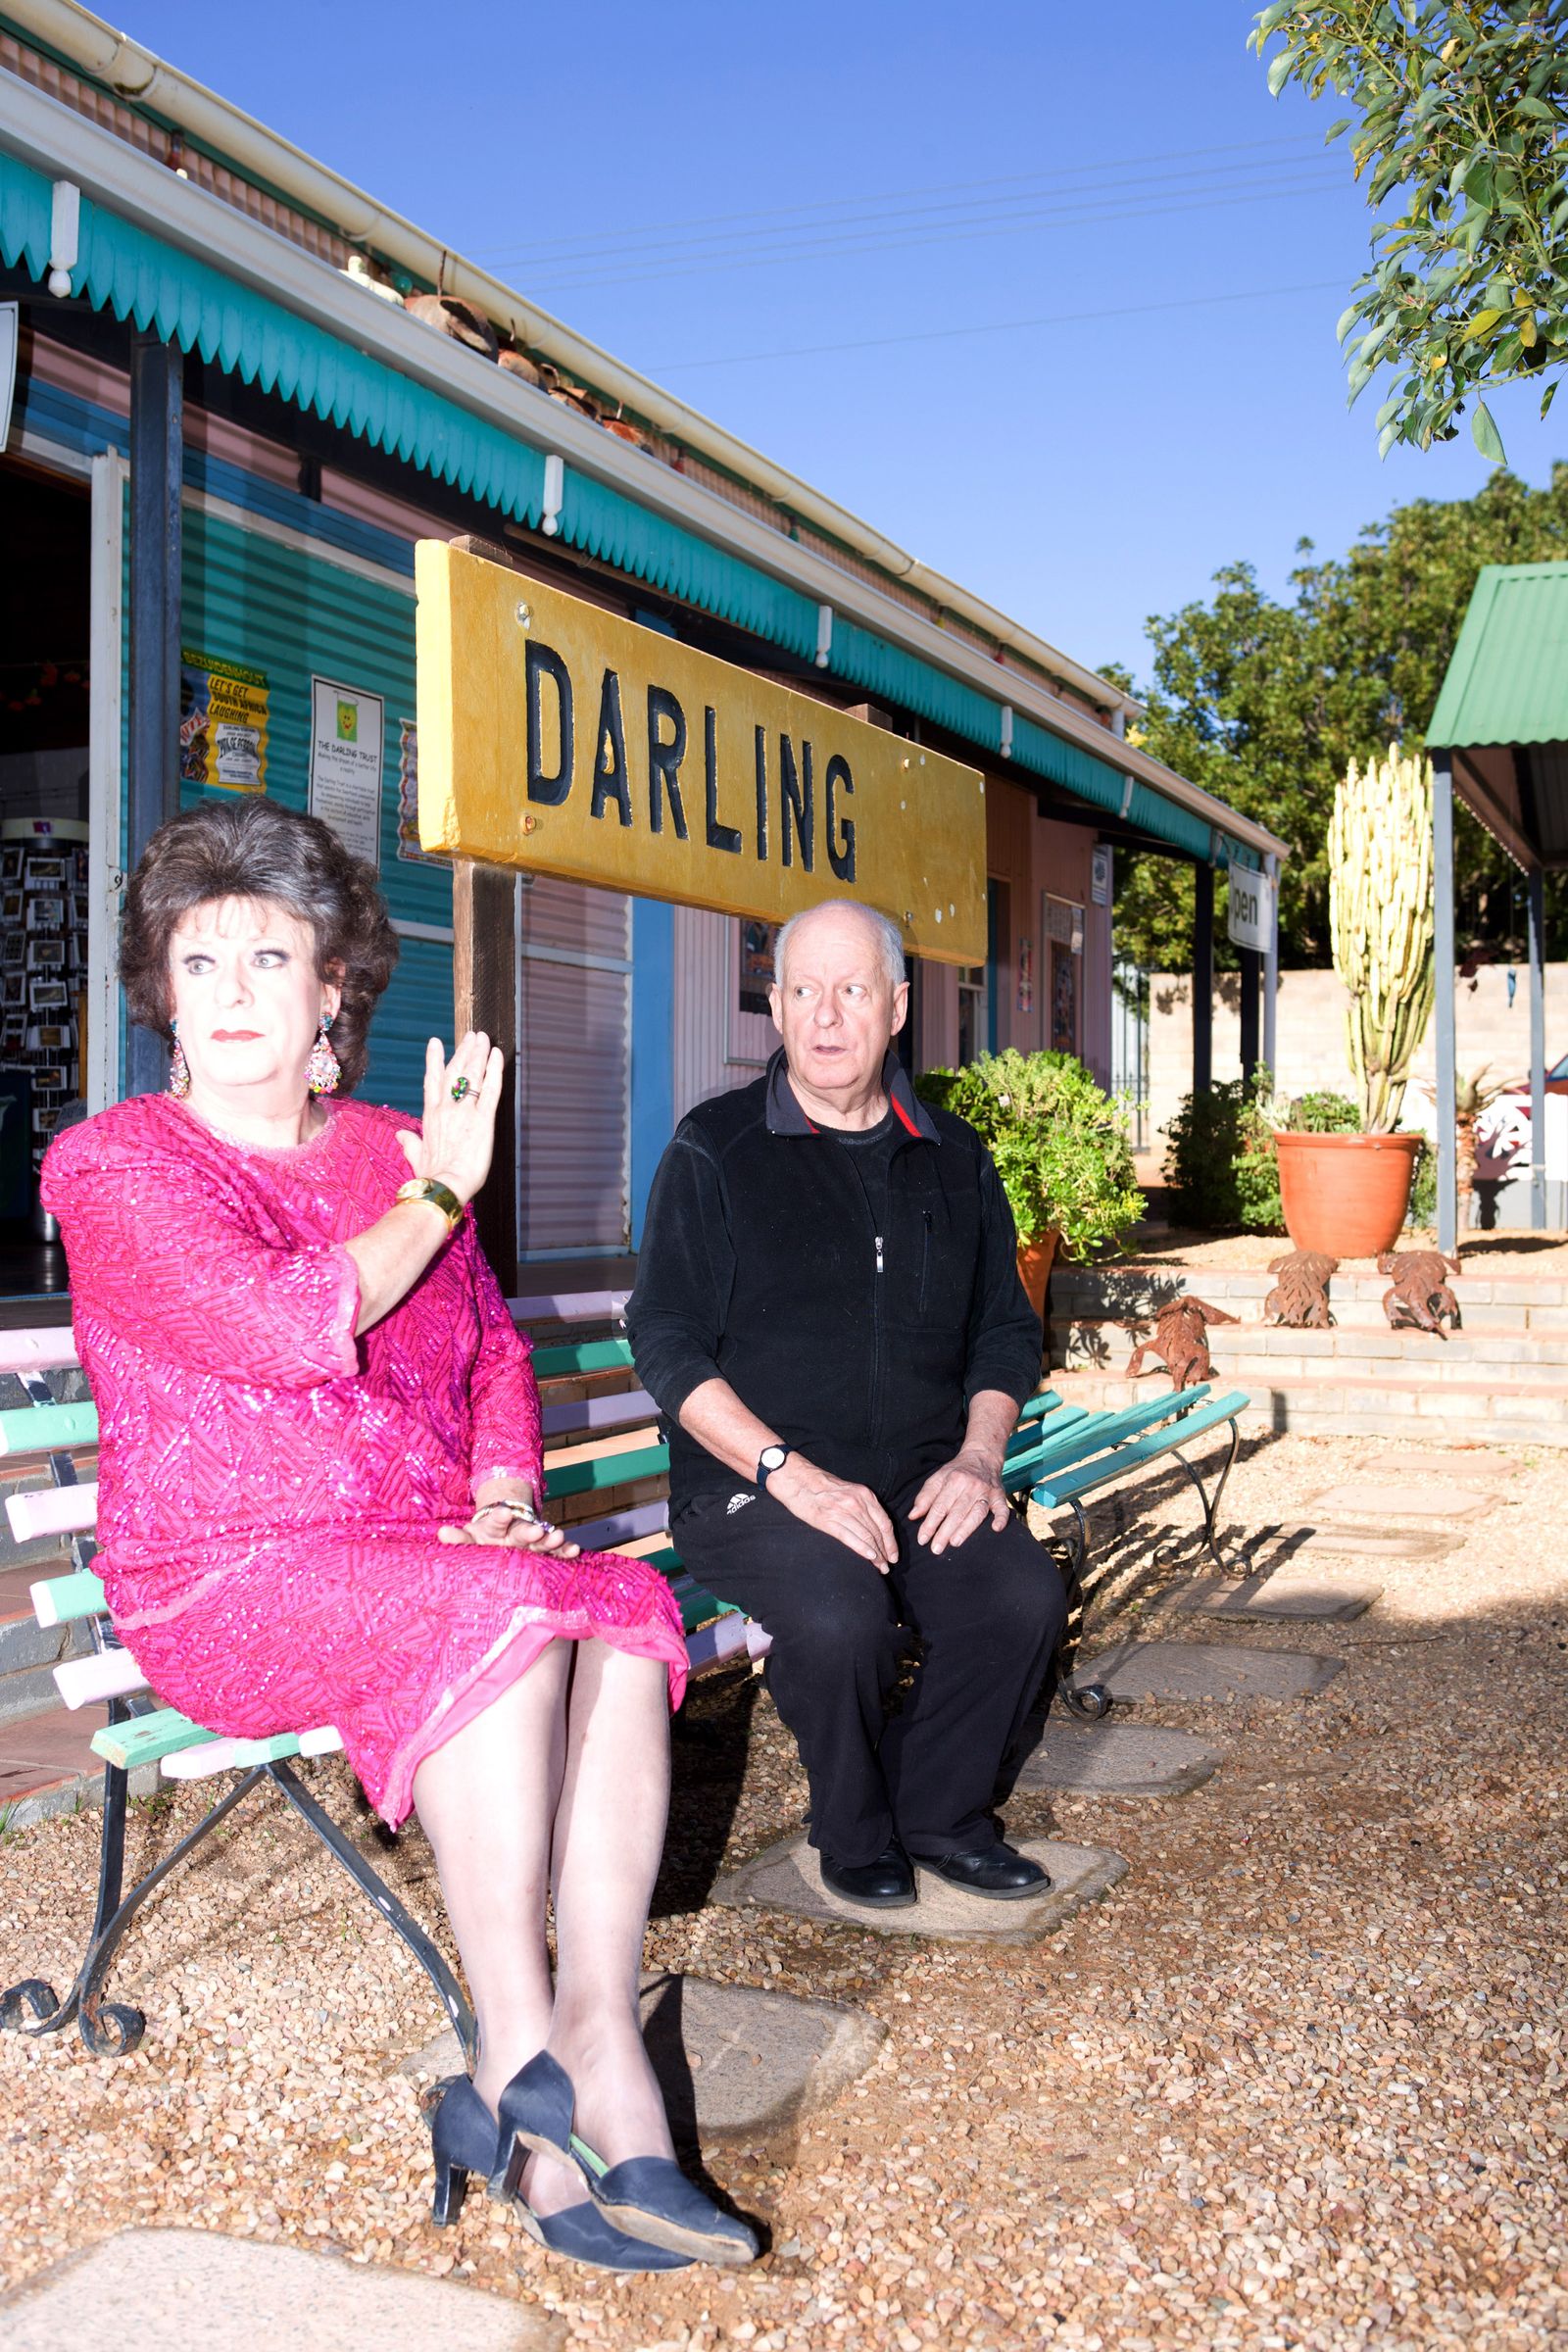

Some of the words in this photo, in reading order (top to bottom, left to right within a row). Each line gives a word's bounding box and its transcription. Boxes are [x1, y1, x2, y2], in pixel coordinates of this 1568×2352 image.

[210, 676, 232, 694] LET'S
[233, 684, 249, 699] GET
[209, 703, 249, 723] LAUGHING
[318, 740, 330, 752] THE
[331, 744, 358, 759] DARLING
[359, 751, 377, 764] TRUST
[524, 639, 858, 884] DARLING
[1230, 886, 1258, 929] pen
[726, 1494, 757, 1515] adidas
